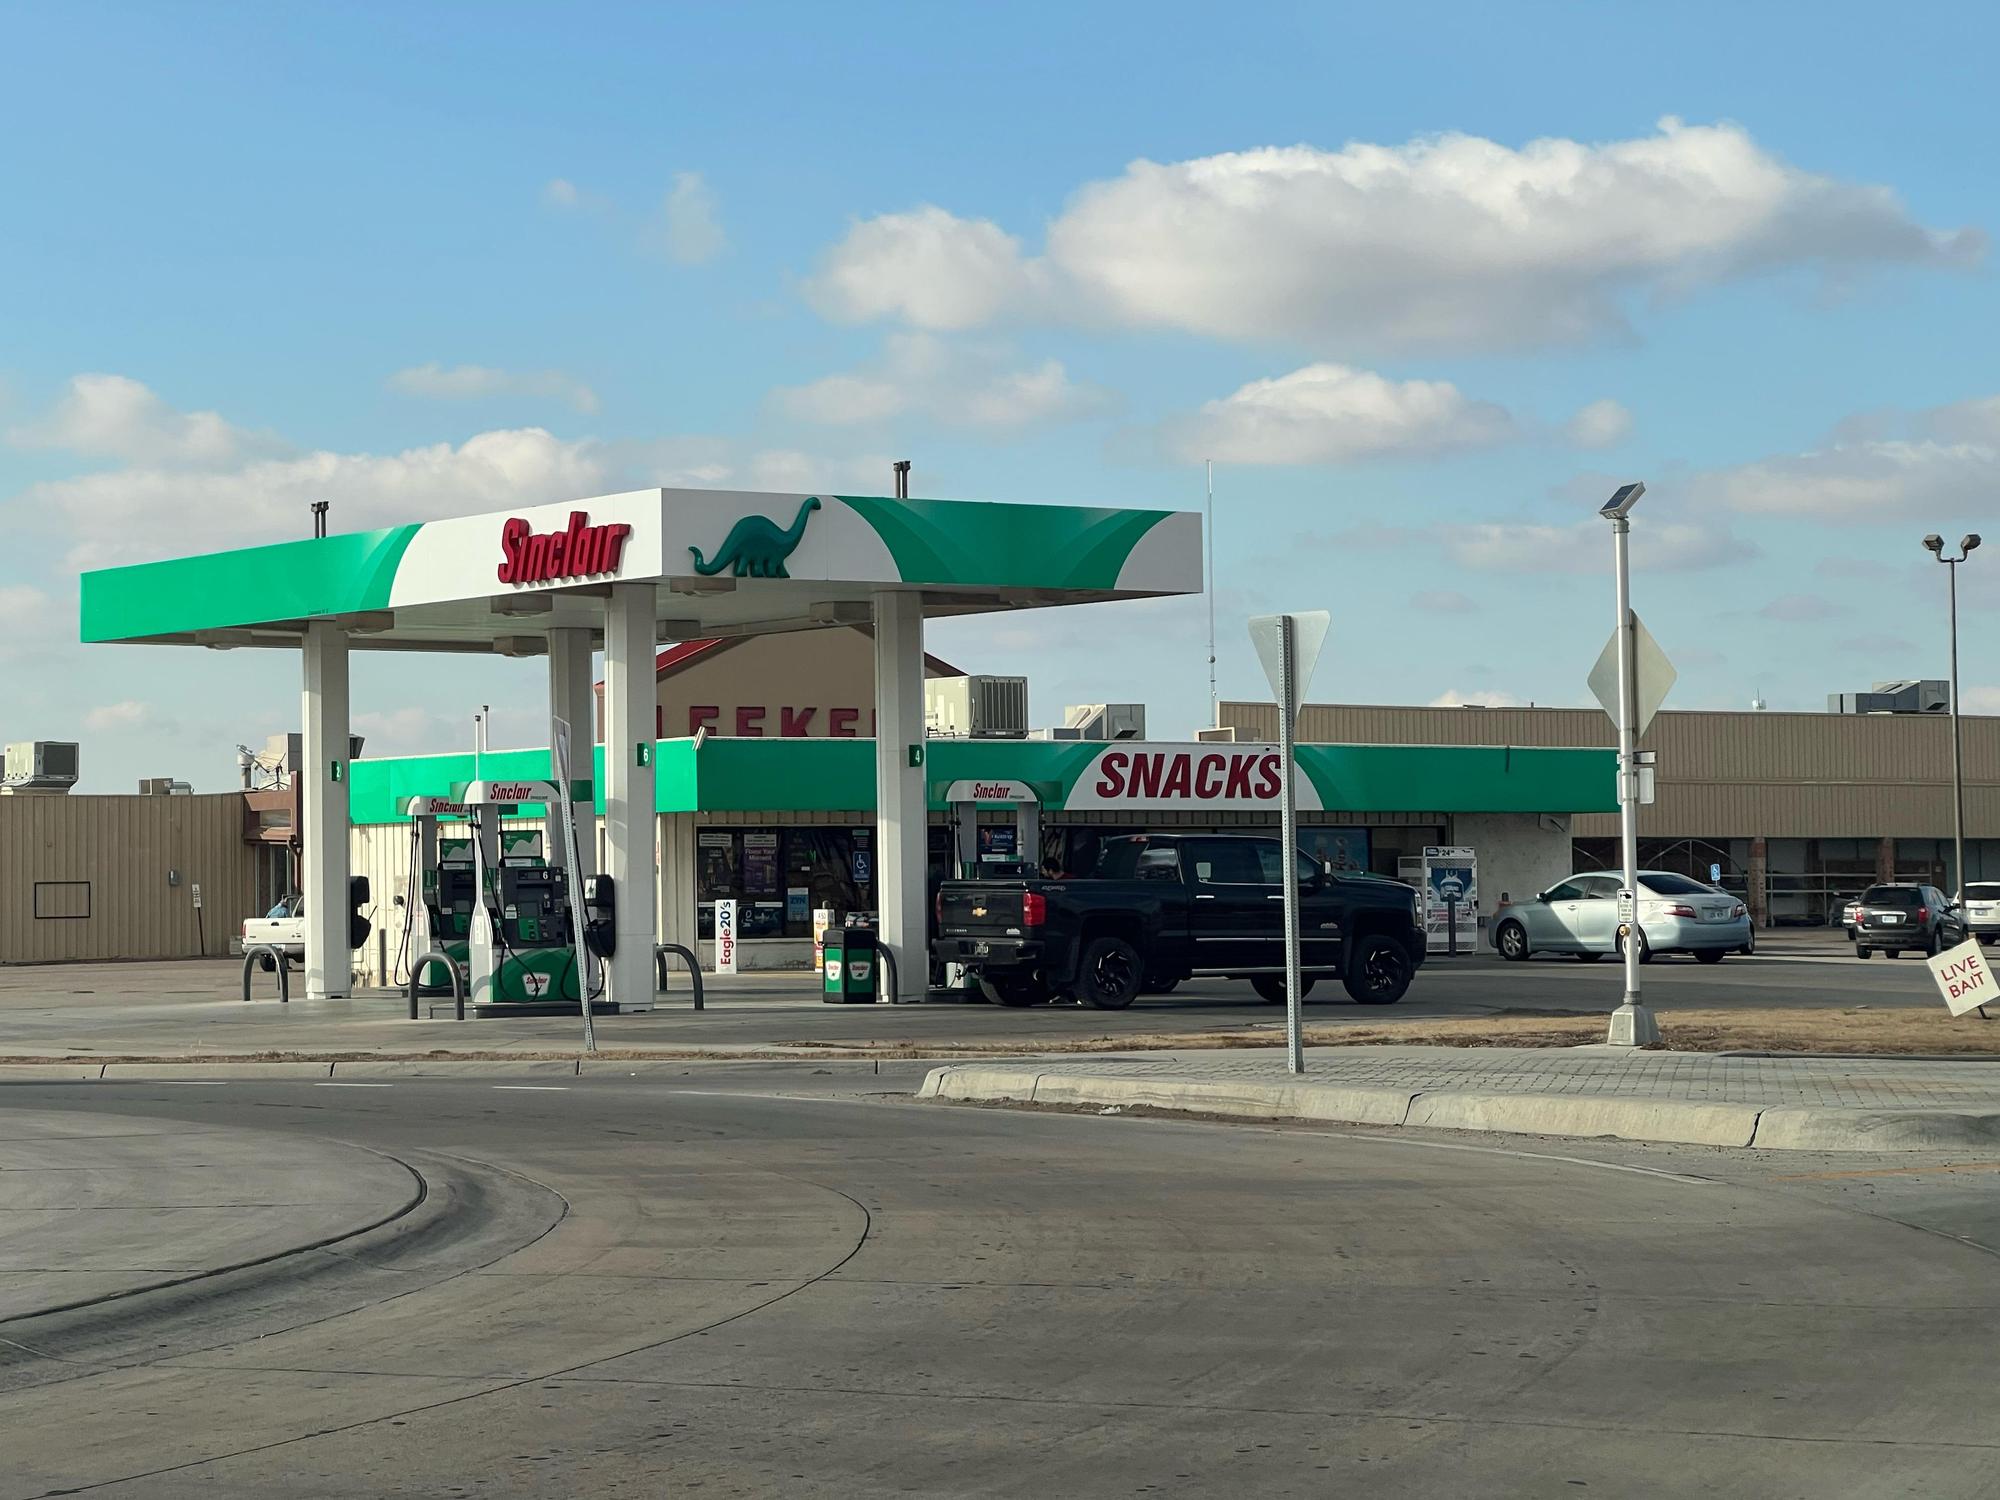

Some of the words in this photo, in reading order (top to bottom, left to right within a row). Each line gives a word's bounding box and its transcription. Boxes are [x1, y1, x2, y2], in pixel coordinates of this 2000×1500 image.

[498, 511, 631, 583] Sinclair
[643, 748, 649, 762] 6
[915, 750, 920, 763] 4
[336, 766, 341, 778] 2
[1096, 752, 1282, 800] SNACKS
[490, 783, 532, 800] Sinclair
[973, 783, 1010, 799] Sinclair
[542, 871, 548, 880] 6
[1941, 955, 1979, 981] LIVE
[1949, 971, 1984, 998] BAIT
